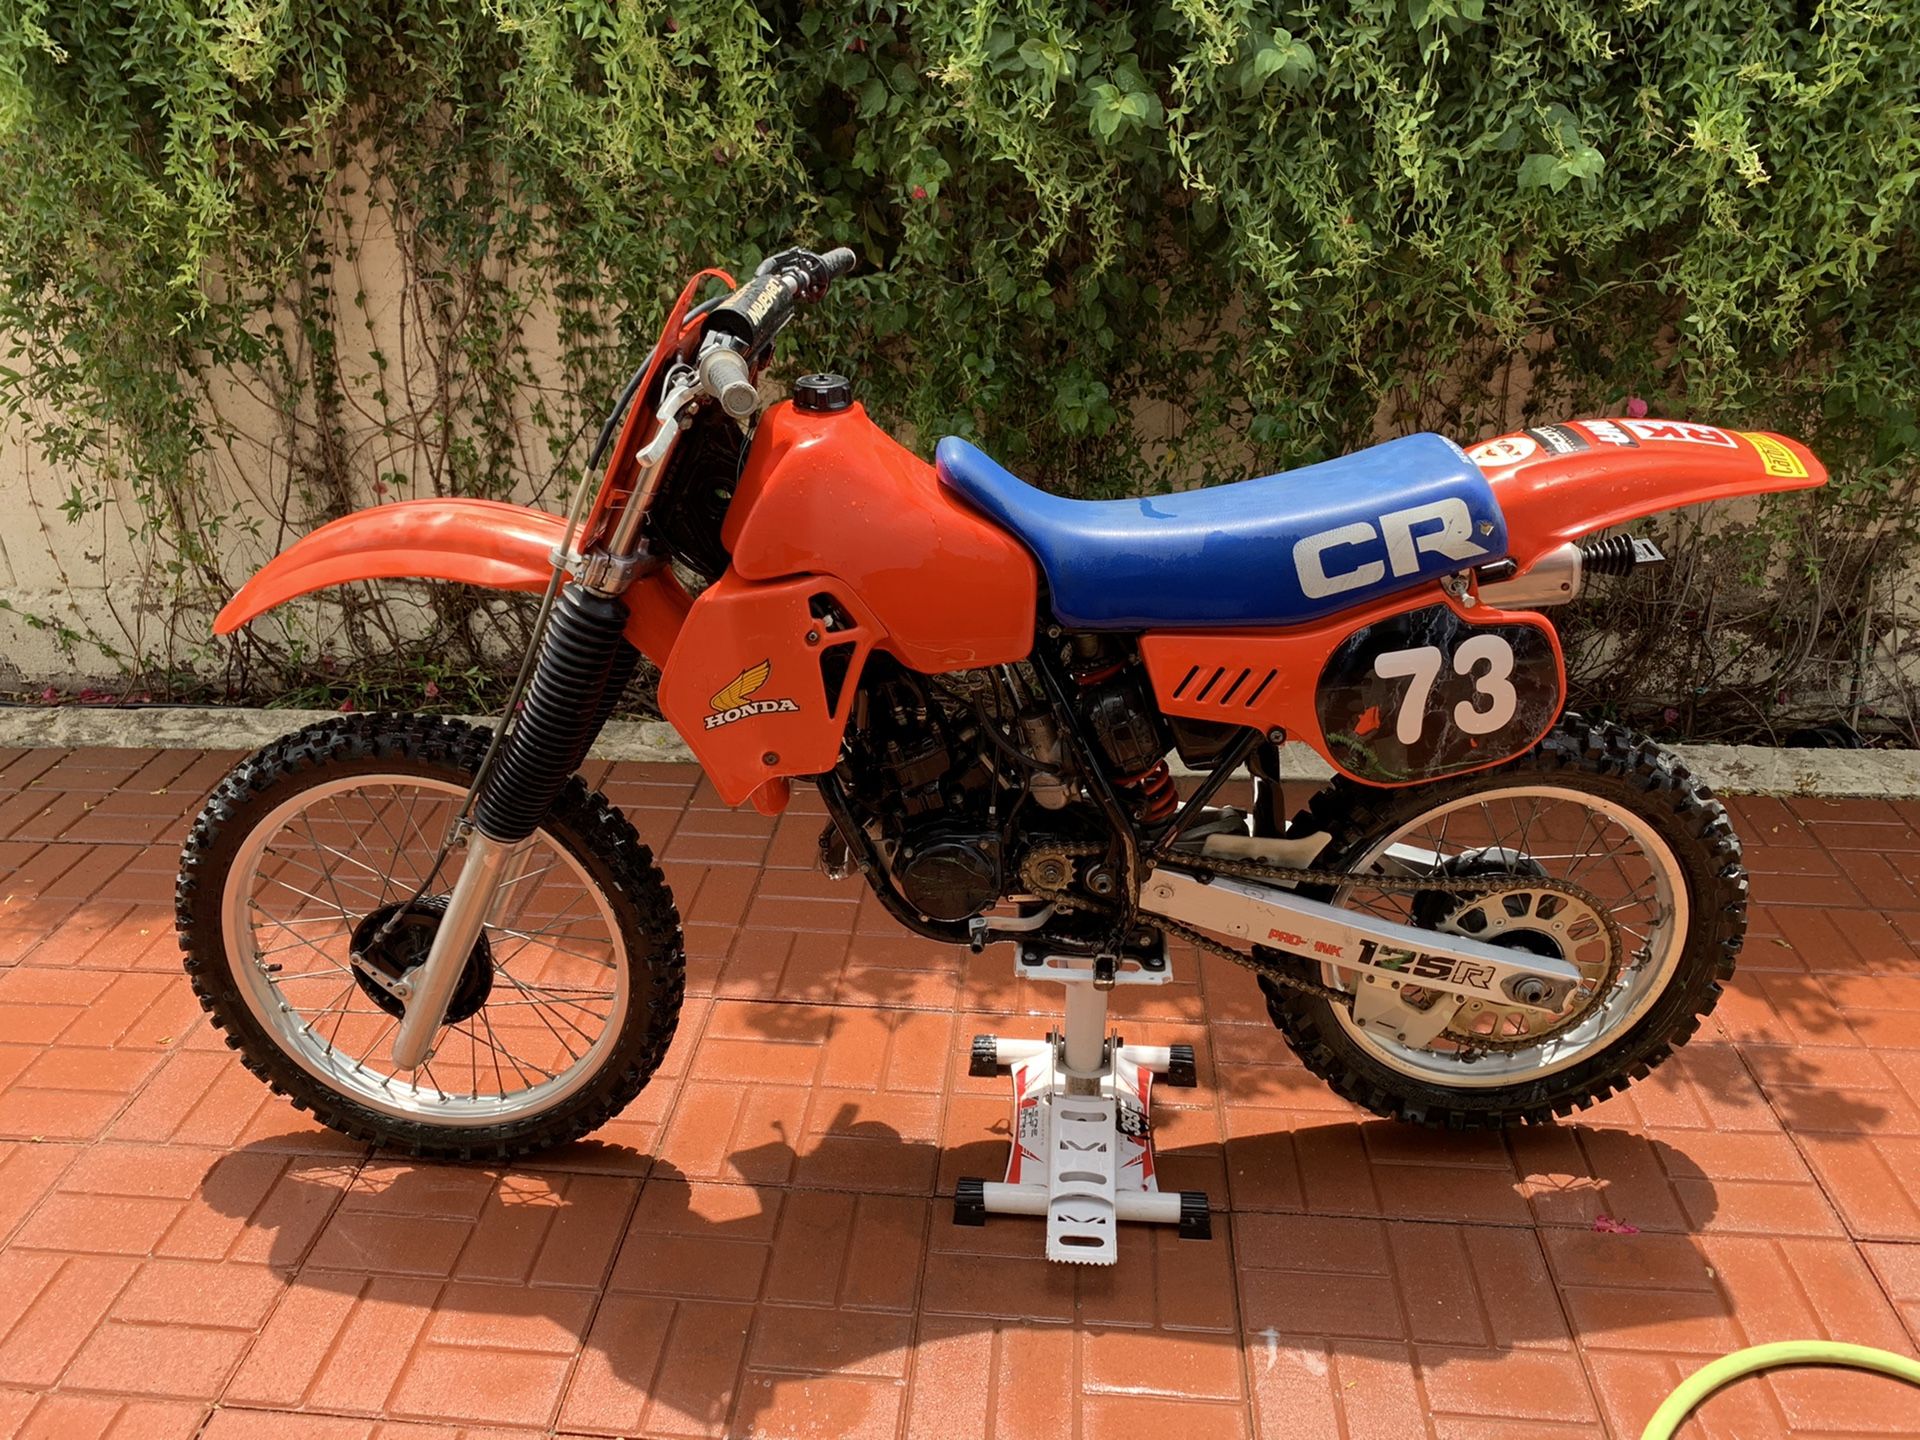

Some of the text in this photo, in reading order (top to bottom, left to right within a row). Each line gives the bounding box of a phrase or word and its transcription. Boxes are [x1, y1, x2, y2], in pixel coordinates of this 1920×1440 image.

[1637, 424, 1730, 445] RK
[1292, 497, 1490, 600] CR
[704, 699, 799, 730] HONDA
[1374, 634, 1517, 745] 73
[1358, 938, 1497, 990] 125R
